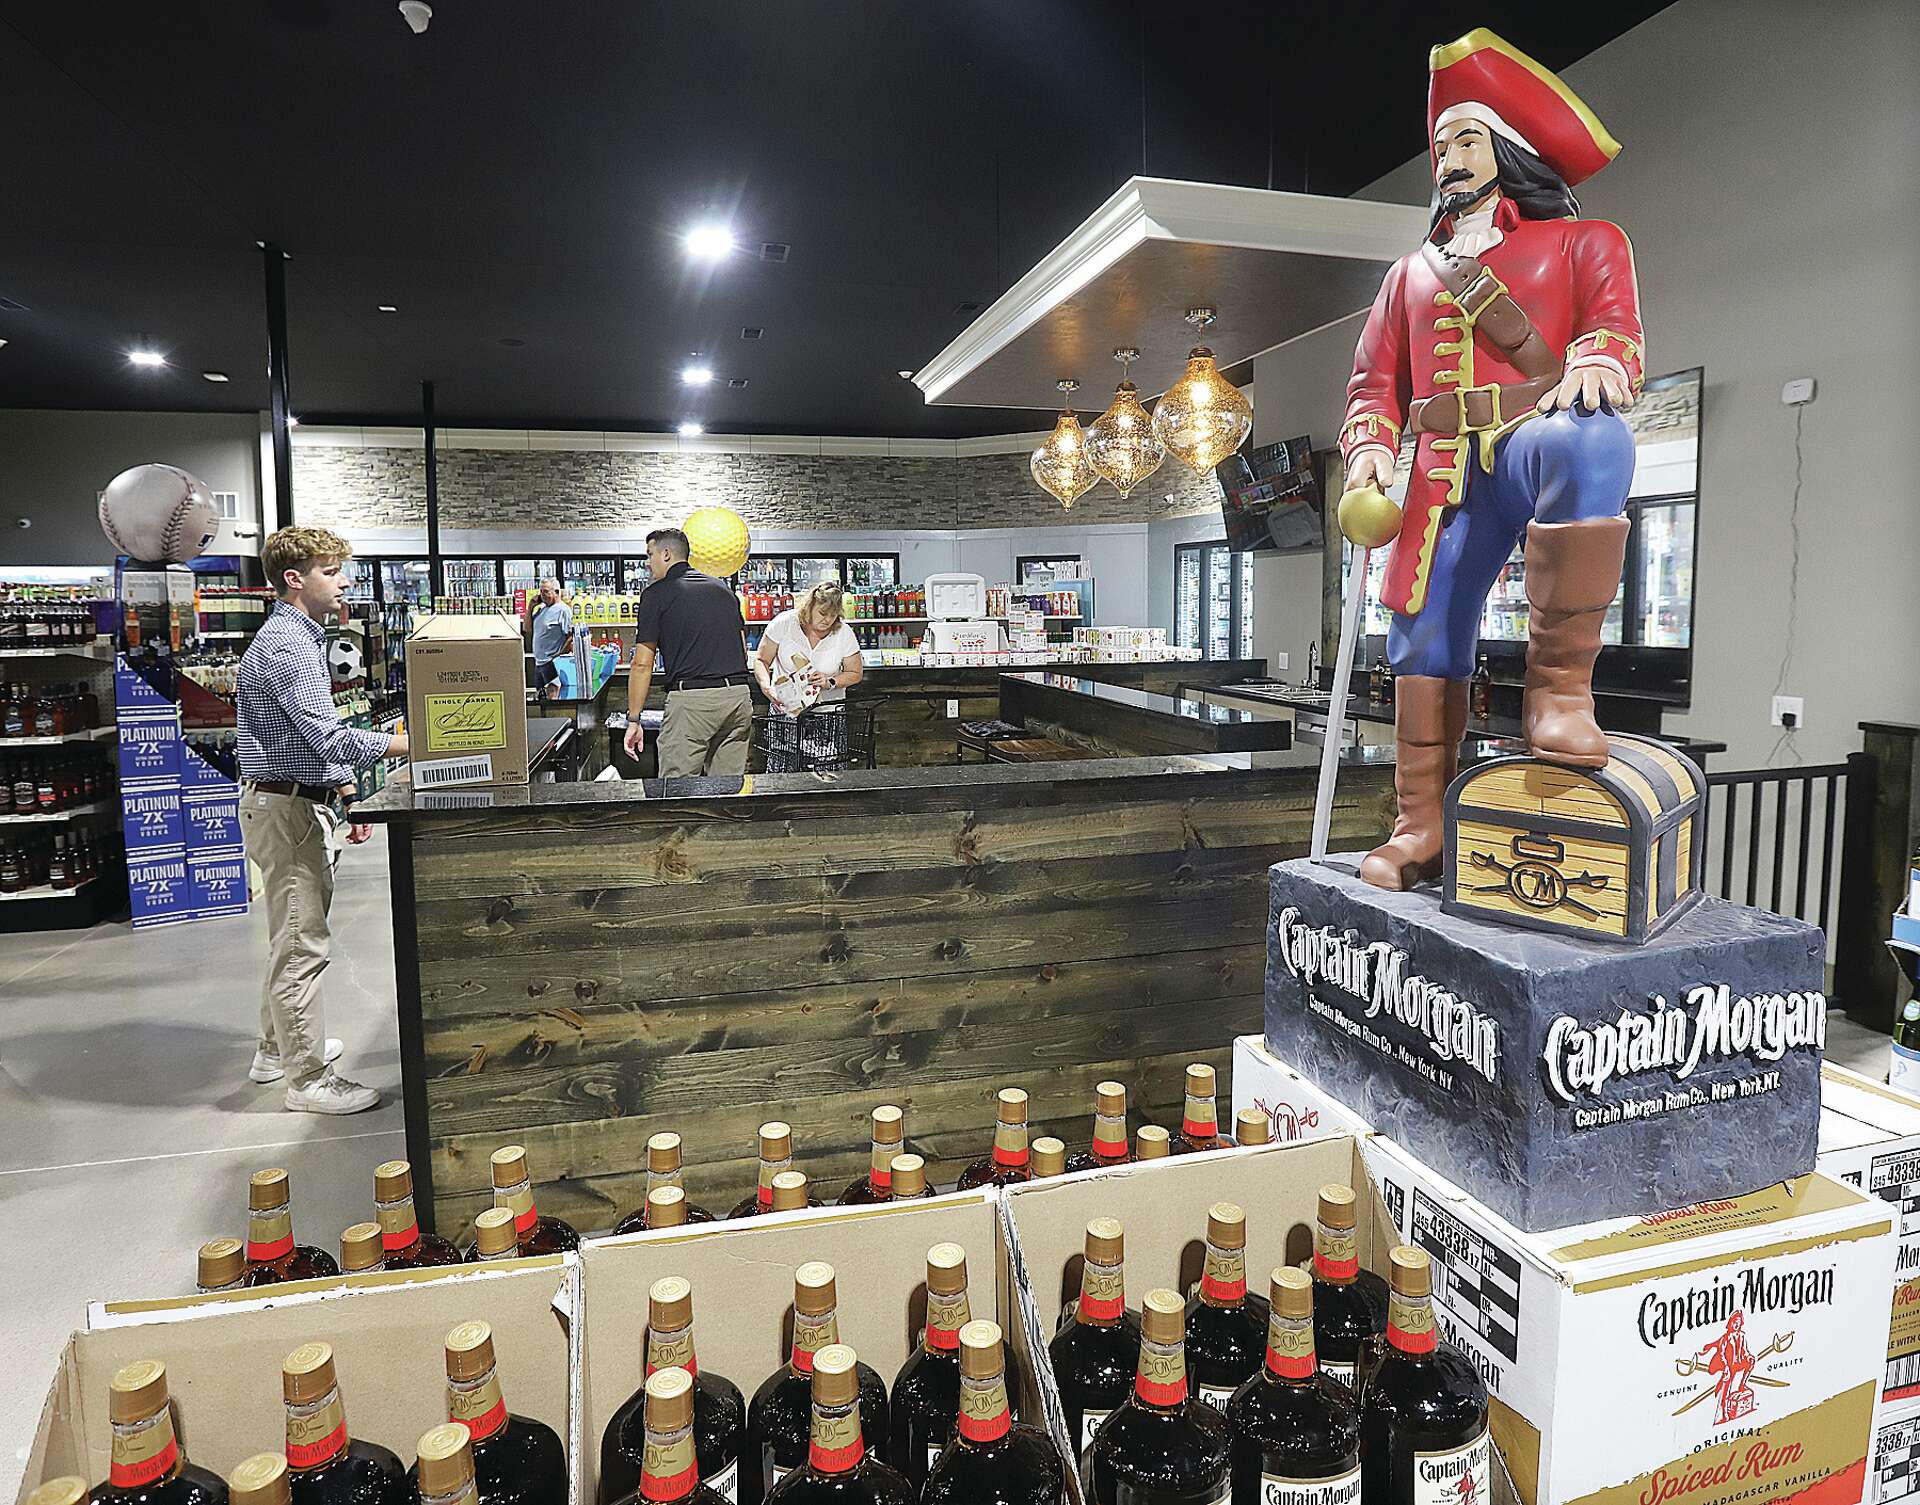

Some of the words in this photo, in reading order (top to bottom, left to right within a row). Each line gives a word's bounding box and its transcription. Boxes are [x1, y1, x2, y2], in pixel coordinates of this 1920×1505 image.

[120, 726, 176, 743] PLATINUM
[138, 742, 159, 754] 7X
[124, 795, 180, 815] PLATINUM
[190, 804, 236, 821] PLATINUM
[142, 811, 164, 824] 7X
[206, 818, 223, 829] 7X
[129, 863, 185, 885] PLATINUM
[195, 865, 240, 883] PLATINUM
[148, 880, 169, 893] 7X
[210, 879, 227, 890] 7X
[1278, 906, 1371, 1001] Captain
[1361, 941, 1500, 1082] Morgan
[1309, 993, 1334, 1021] Captain
[1335, 1008, 1361, 1038] Morgan
[1362, 1027, 1380, 1047] Rum
[1398, 1045, 1417, 1067] New
[1418, 1054, 1436, 1082] York
[1542, 993, 1688, 1101] Captain
[1676, 984, 1827, 1080] Morgan
[1575, 1103, 1620, 1128] Captain
[1623, 1096, 1662, 1120] Morgan
[1665, 1092, 1690, 1112] Rum
[1711, 1081, 1735, 1101] New
[1430, 1215, 1470, 1260] 43338
[1470, 1252, 1479, 1268] 17
[1637, 1275, 1735, 1349] Captain
[1737, 1266, 1834, 1314] Morgan
[1897, 1334, 1916, 1347] WITH
[1766, 1357, 1804, 1372] QUALITY
[1656, 1384, 1698, 1399] GENUINE
[1694, 1427, 1763, 1454] ORIGINAL
[1419, 1456, 1467, 1483] Captain
[1640, 1451, 1736, 1505] Spiced
[1736, 1441, 1804, 1480] Rum
[1784, 1467, 1831, 1487] VANILLA
[1265, 1483, 1318, 1505] Captain
[1318, 1479, 1361, 1505] Morgan
